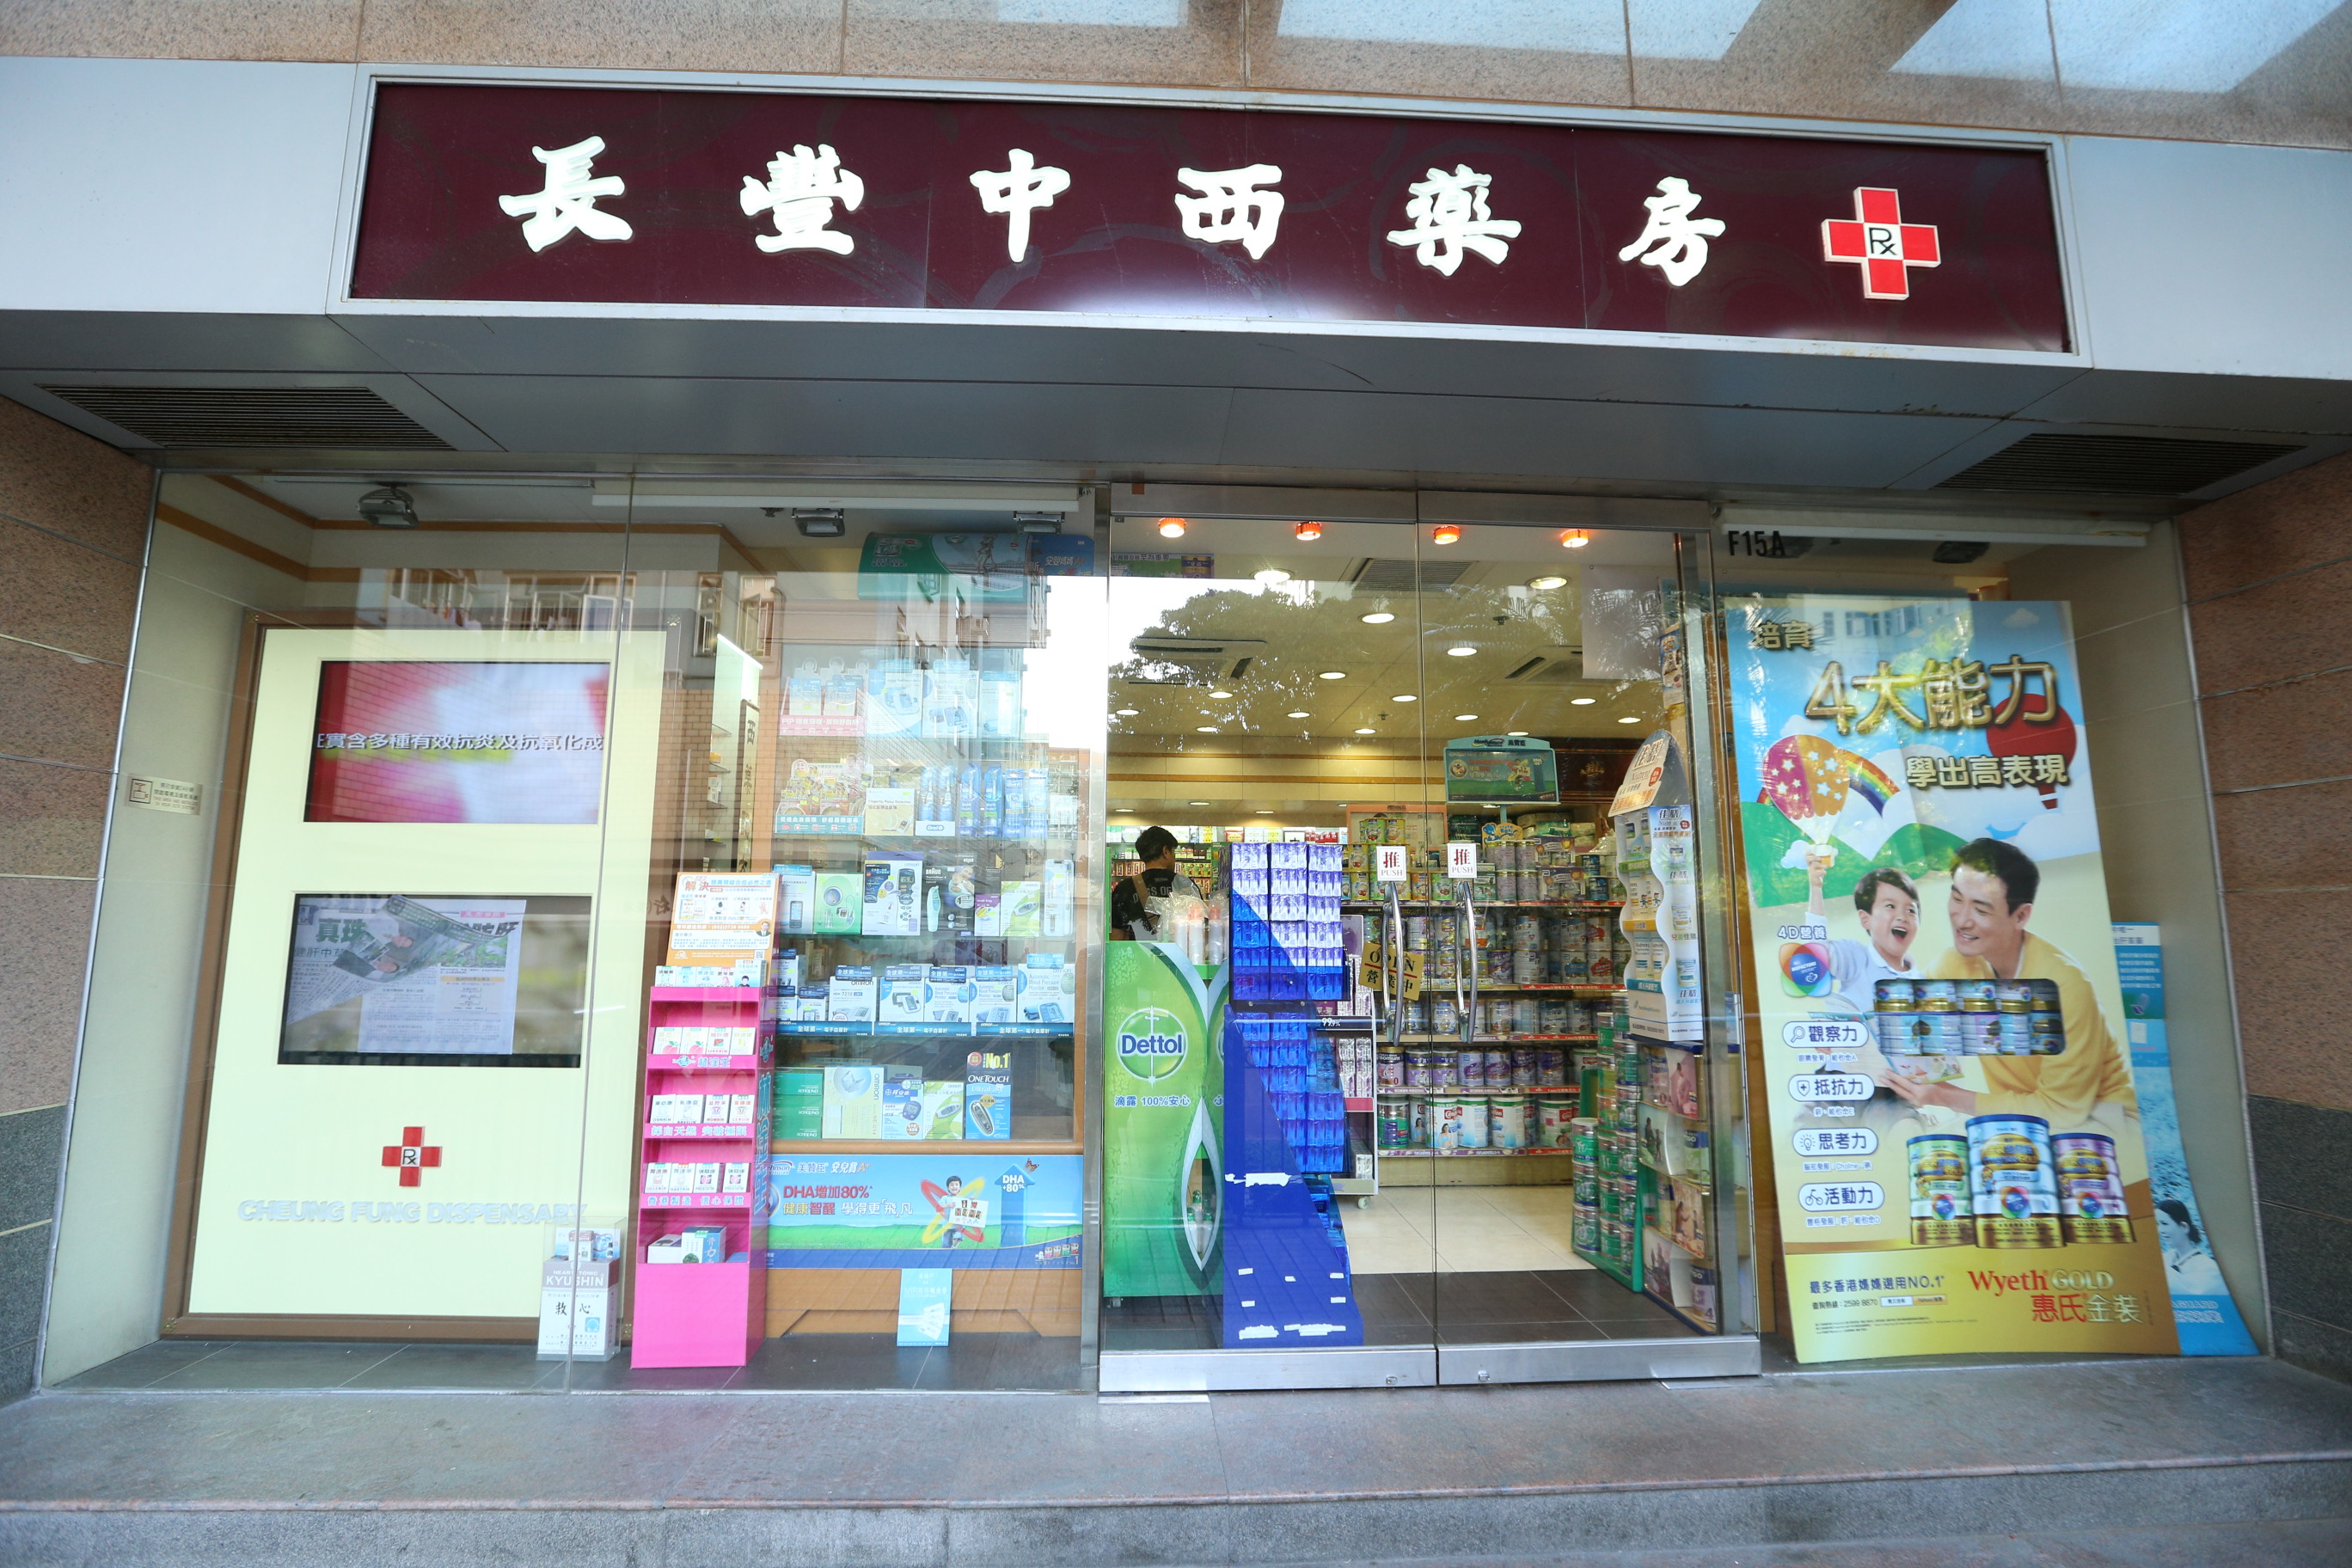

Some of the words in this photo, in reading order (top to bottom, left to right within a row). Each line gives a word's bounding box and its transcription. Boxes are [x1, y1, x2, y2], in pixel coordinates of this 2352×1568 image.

[499, 136, 1725, 286] 長豐中西藥房
[1728, 530, 1785, 557] F15A
[1805, 654, 2060, 735] 4大能力
[1906, 754, 2070, 789] 學出高表現
[1383, 851, 1400, 868] 推
[1454, 848, 1470, 866] 推
[1778, 926, 1827, 940] 4D營養
[1809, 1026, 1858, 1043] 觀察力
[1122, 1035, 1182, 1054] Dettol
[986, 1052, 1010, 1069] No.1
[968, 1075, 1009, 1083] ONETOUCH
[1815, 1078, 1864, 1095] 抵抗力
[1115, 1096, 1136, 1106] 滴露
[1141, 1096, 1190, 1106] 100%安心
[701, 1125, 747, 1136] 突破極限
[1819, 1132, 1866, 1150] 思考力
[1002, 1174, 1025, 1184] DHA
[1002, 1184, 1025, 1192] +80%
[1824, 1187, 1873, 1204] 活動力
[648, 1196, 691, 1205] 香港製造
[701, 1196, 744, 1205] 信心保證
[783, 1202, 835, 1215] 健康智醒
[237, 1200, 346, 1222] CHEUNG
[351, 1201, 421, 1222] FUNG
[1967, 1270, 2049, 1296] Wyeth
[2051, 1269, 2115, 1289] GOLD
